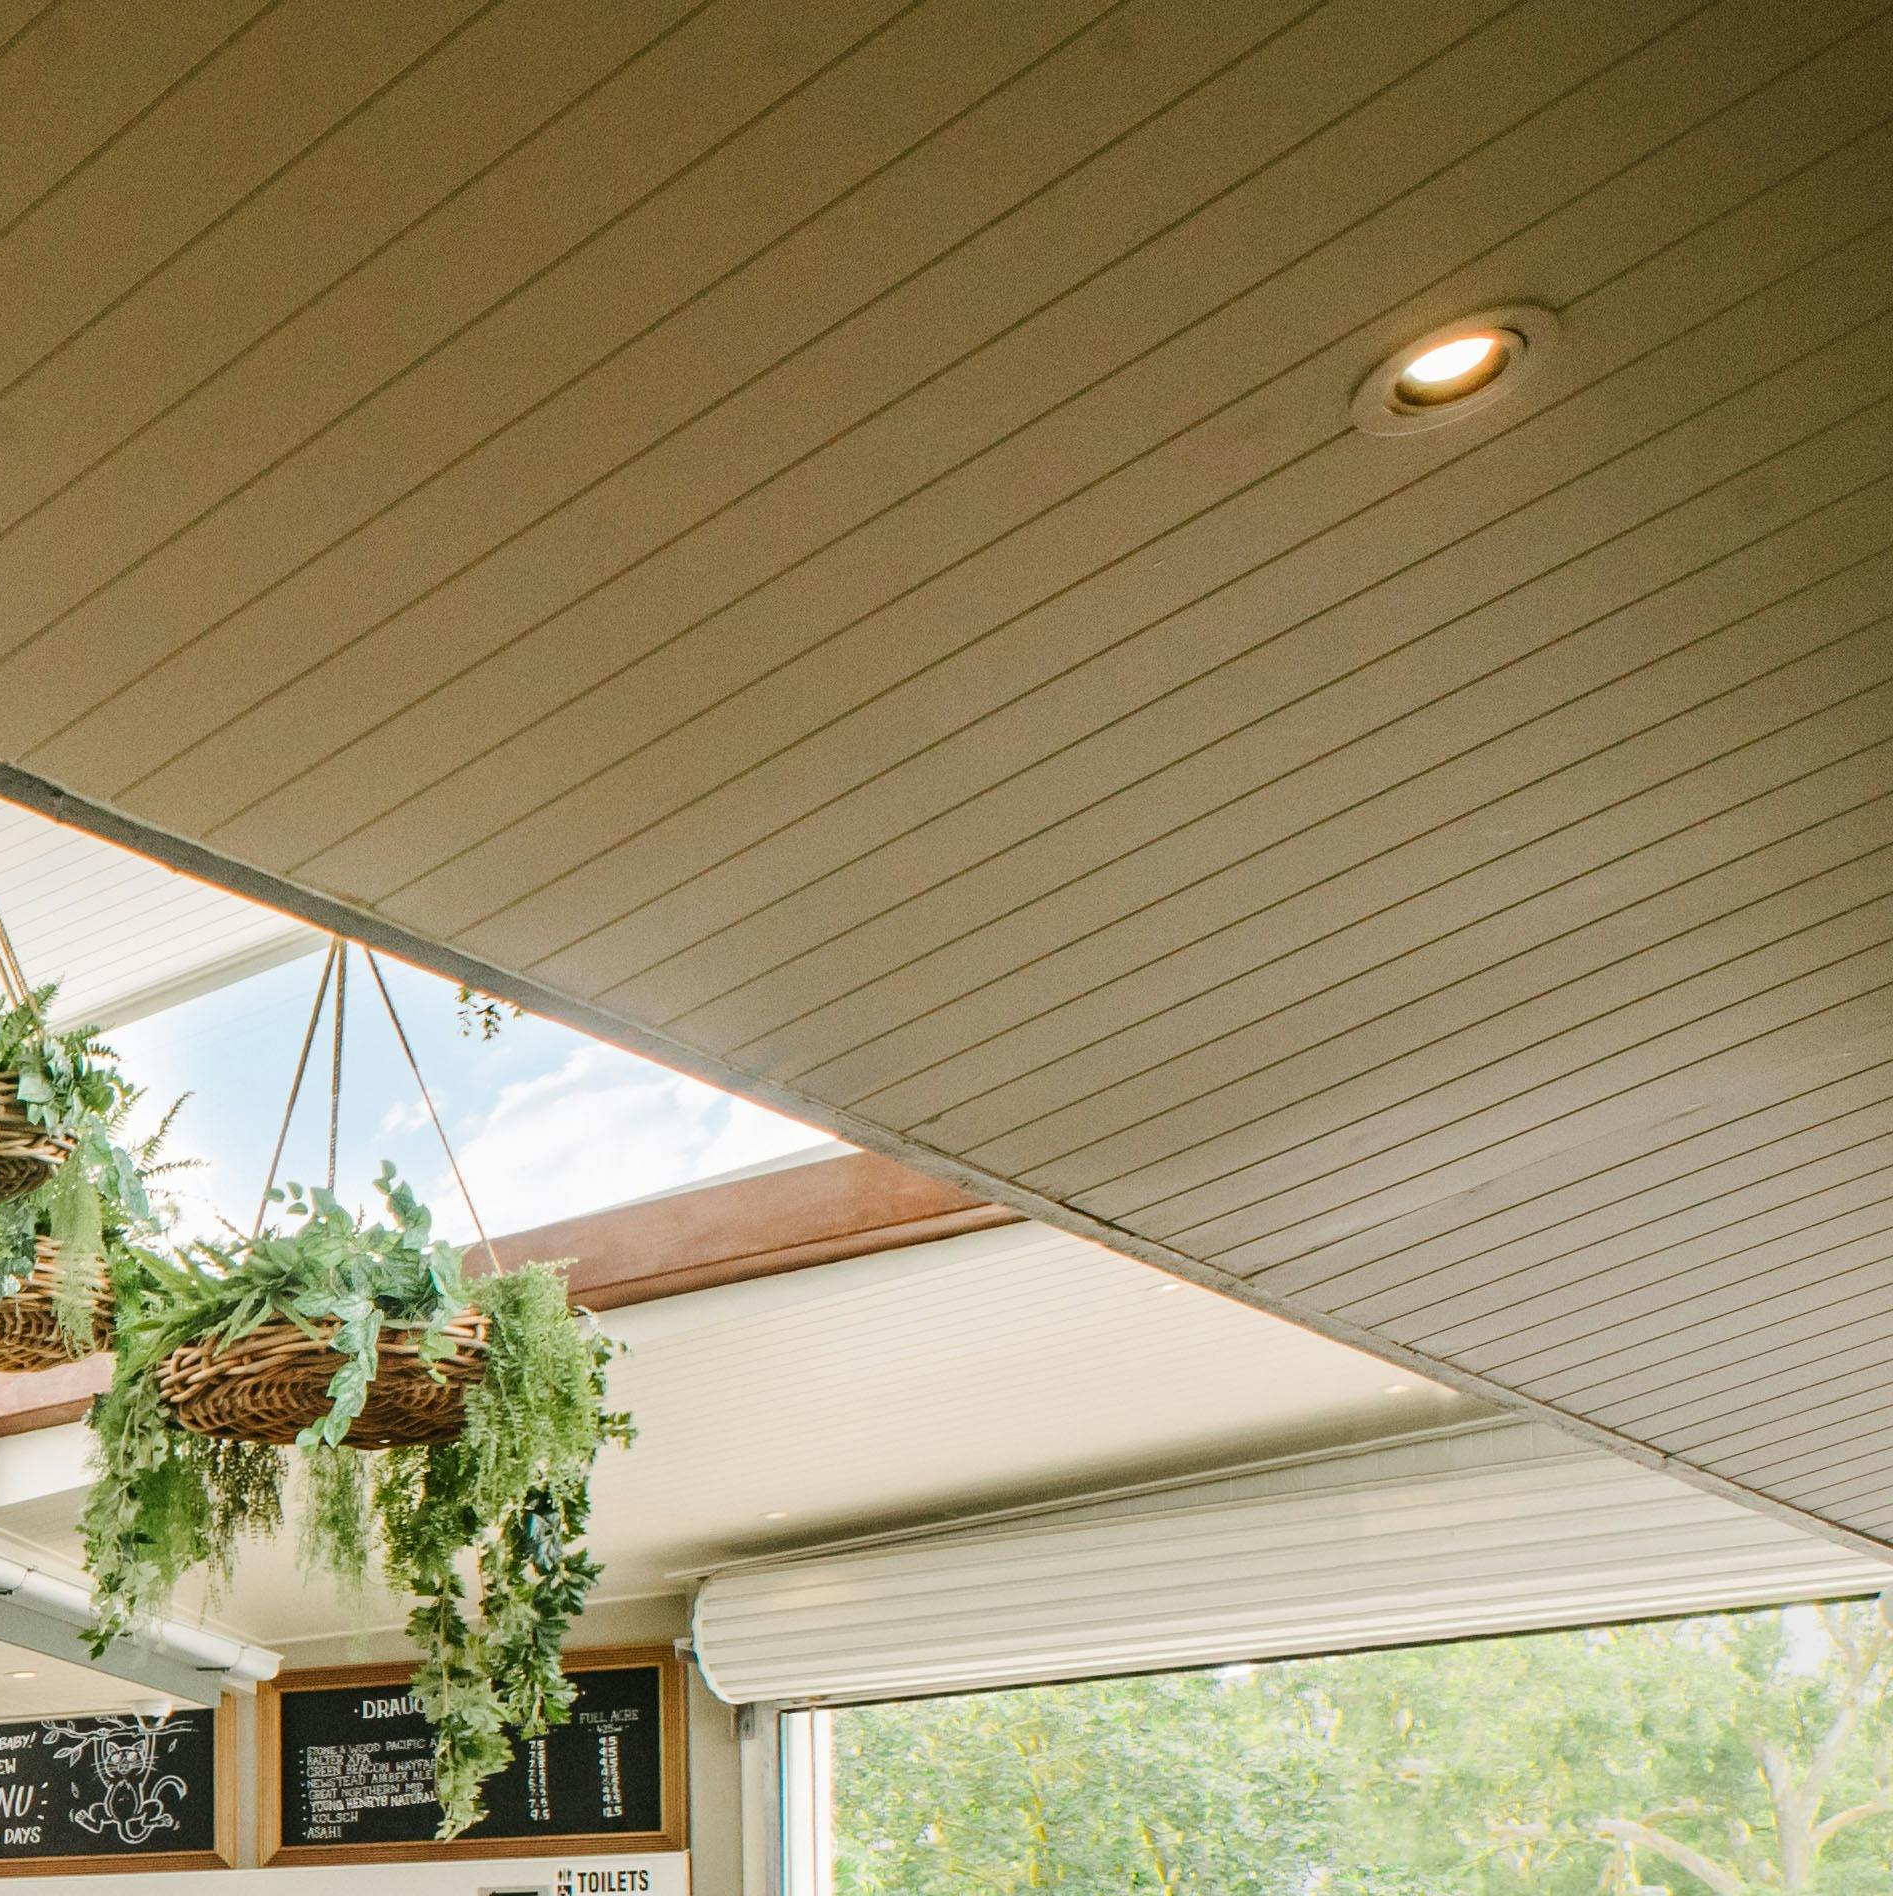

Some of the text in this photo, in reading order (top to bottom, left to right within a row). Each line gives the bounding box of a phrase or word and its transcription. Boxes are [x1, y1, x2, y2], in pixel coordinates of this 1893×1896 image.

[385, 1739, 426, 1751] PACIFIC
[307, 1774, 367, 1789] NEWSTEAD
[371, 1771, 408, 1784] AMBER
[341, 1783, 400, 1798] NORTHERN
[311, 1811, 358, 1824] KOLSCH
[4, 1826, 42, 1844] DAYS
[307, 1826, 342, 1839] ASAHI
[577, 1869, 649, 1893] TOILETS
